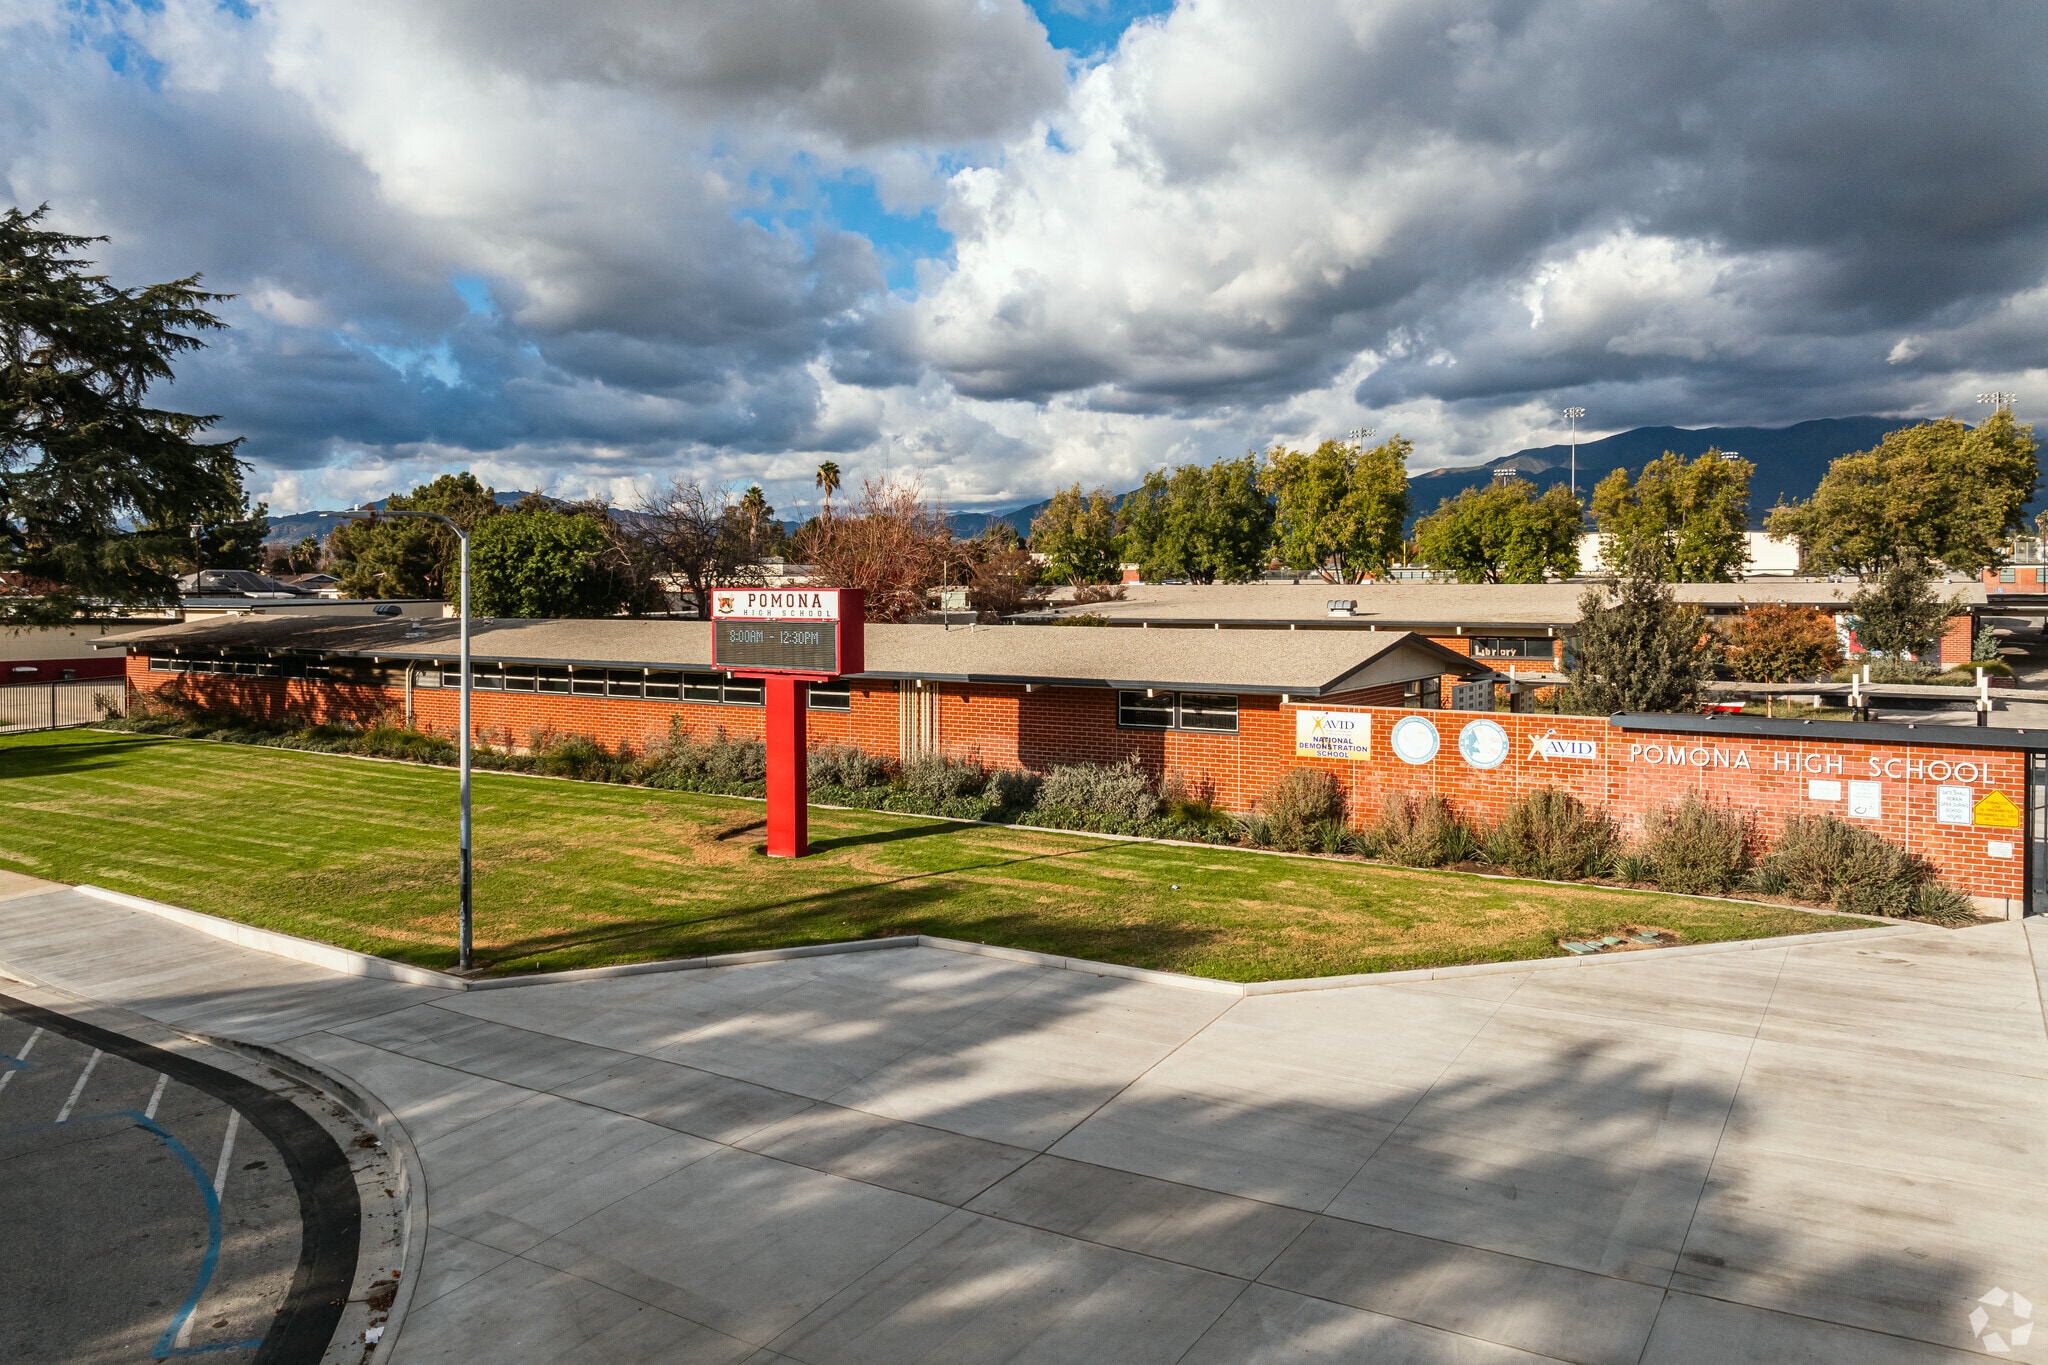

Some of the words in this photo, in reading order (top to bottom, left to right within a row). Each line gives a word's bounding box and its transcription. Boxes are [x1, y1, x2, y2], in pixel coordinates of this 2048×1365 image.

[748, 593, 822, 608] POMONA
[743, 609, 772, 617] HIGH
[782, 609, 831, 617] SCHOOL
[729, 629, 764, 643] 8:00AM
[780, 630, 819, 645] 12:30PM
[1474, 645, 1517, 657] Library
[1323, 720, 1355, 730] AVID
[1313, 736, 1353, 745] NATIONAL
[1299, 742, 1368, 752] DEMONSTRATION
[1545, 741, 1593, 755] AVID
[1316, 750, 1350, 758] SCHOOL
[1631, 744, 1751, 769] POMONA
[1773, 751, 1844, 775] HIGH
[1868, 756, 1997, 785] SCHOOL
